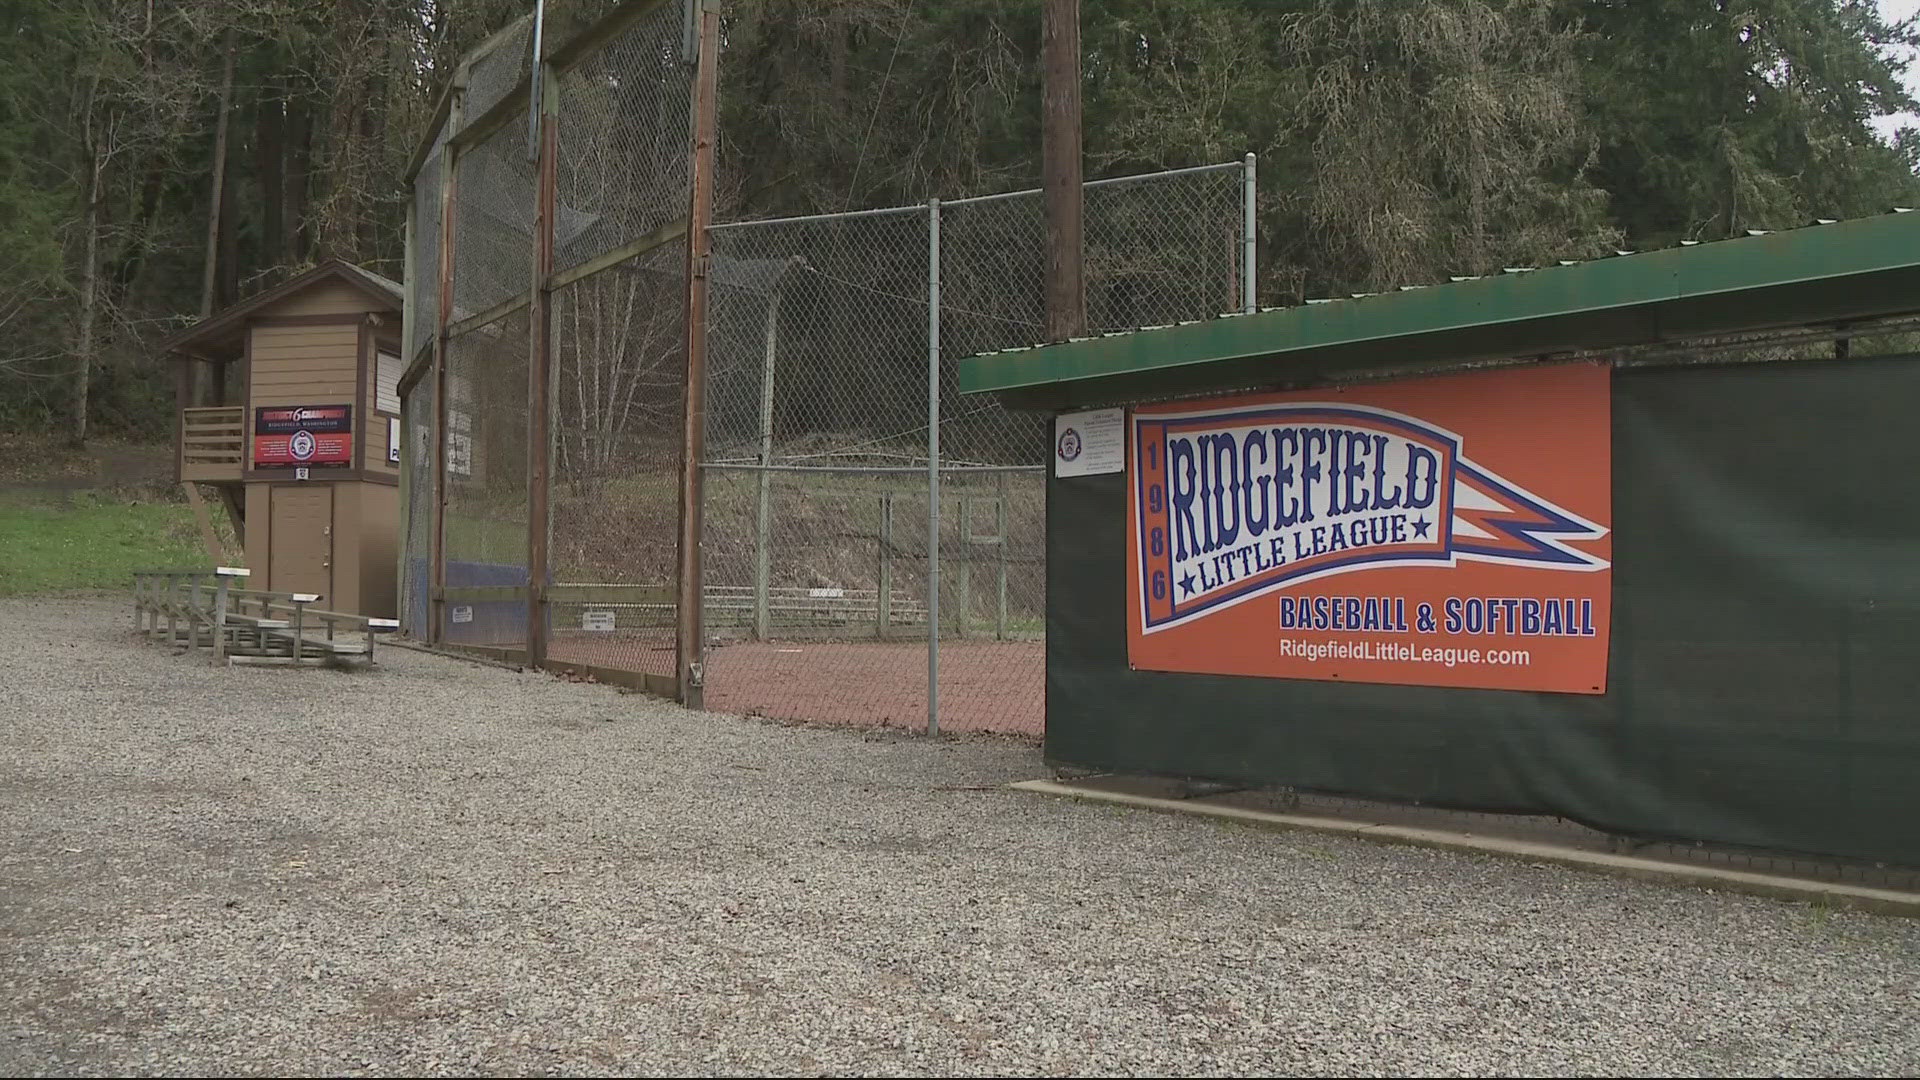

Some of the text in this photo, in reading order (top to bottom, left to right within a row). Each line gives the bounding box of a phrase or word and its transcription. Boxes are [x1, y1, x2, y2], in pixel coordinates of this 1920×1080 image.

[1170, 428, 1438, 562] RIDGEFIELD
[1198, 514, 1407, 593] LITTLE LEAGUE
[1279, 595, 1596, 637] BASEBALL & SOFTBALL
[1280, 640, 1531, 667] RidgefieldLittleLeague.com
